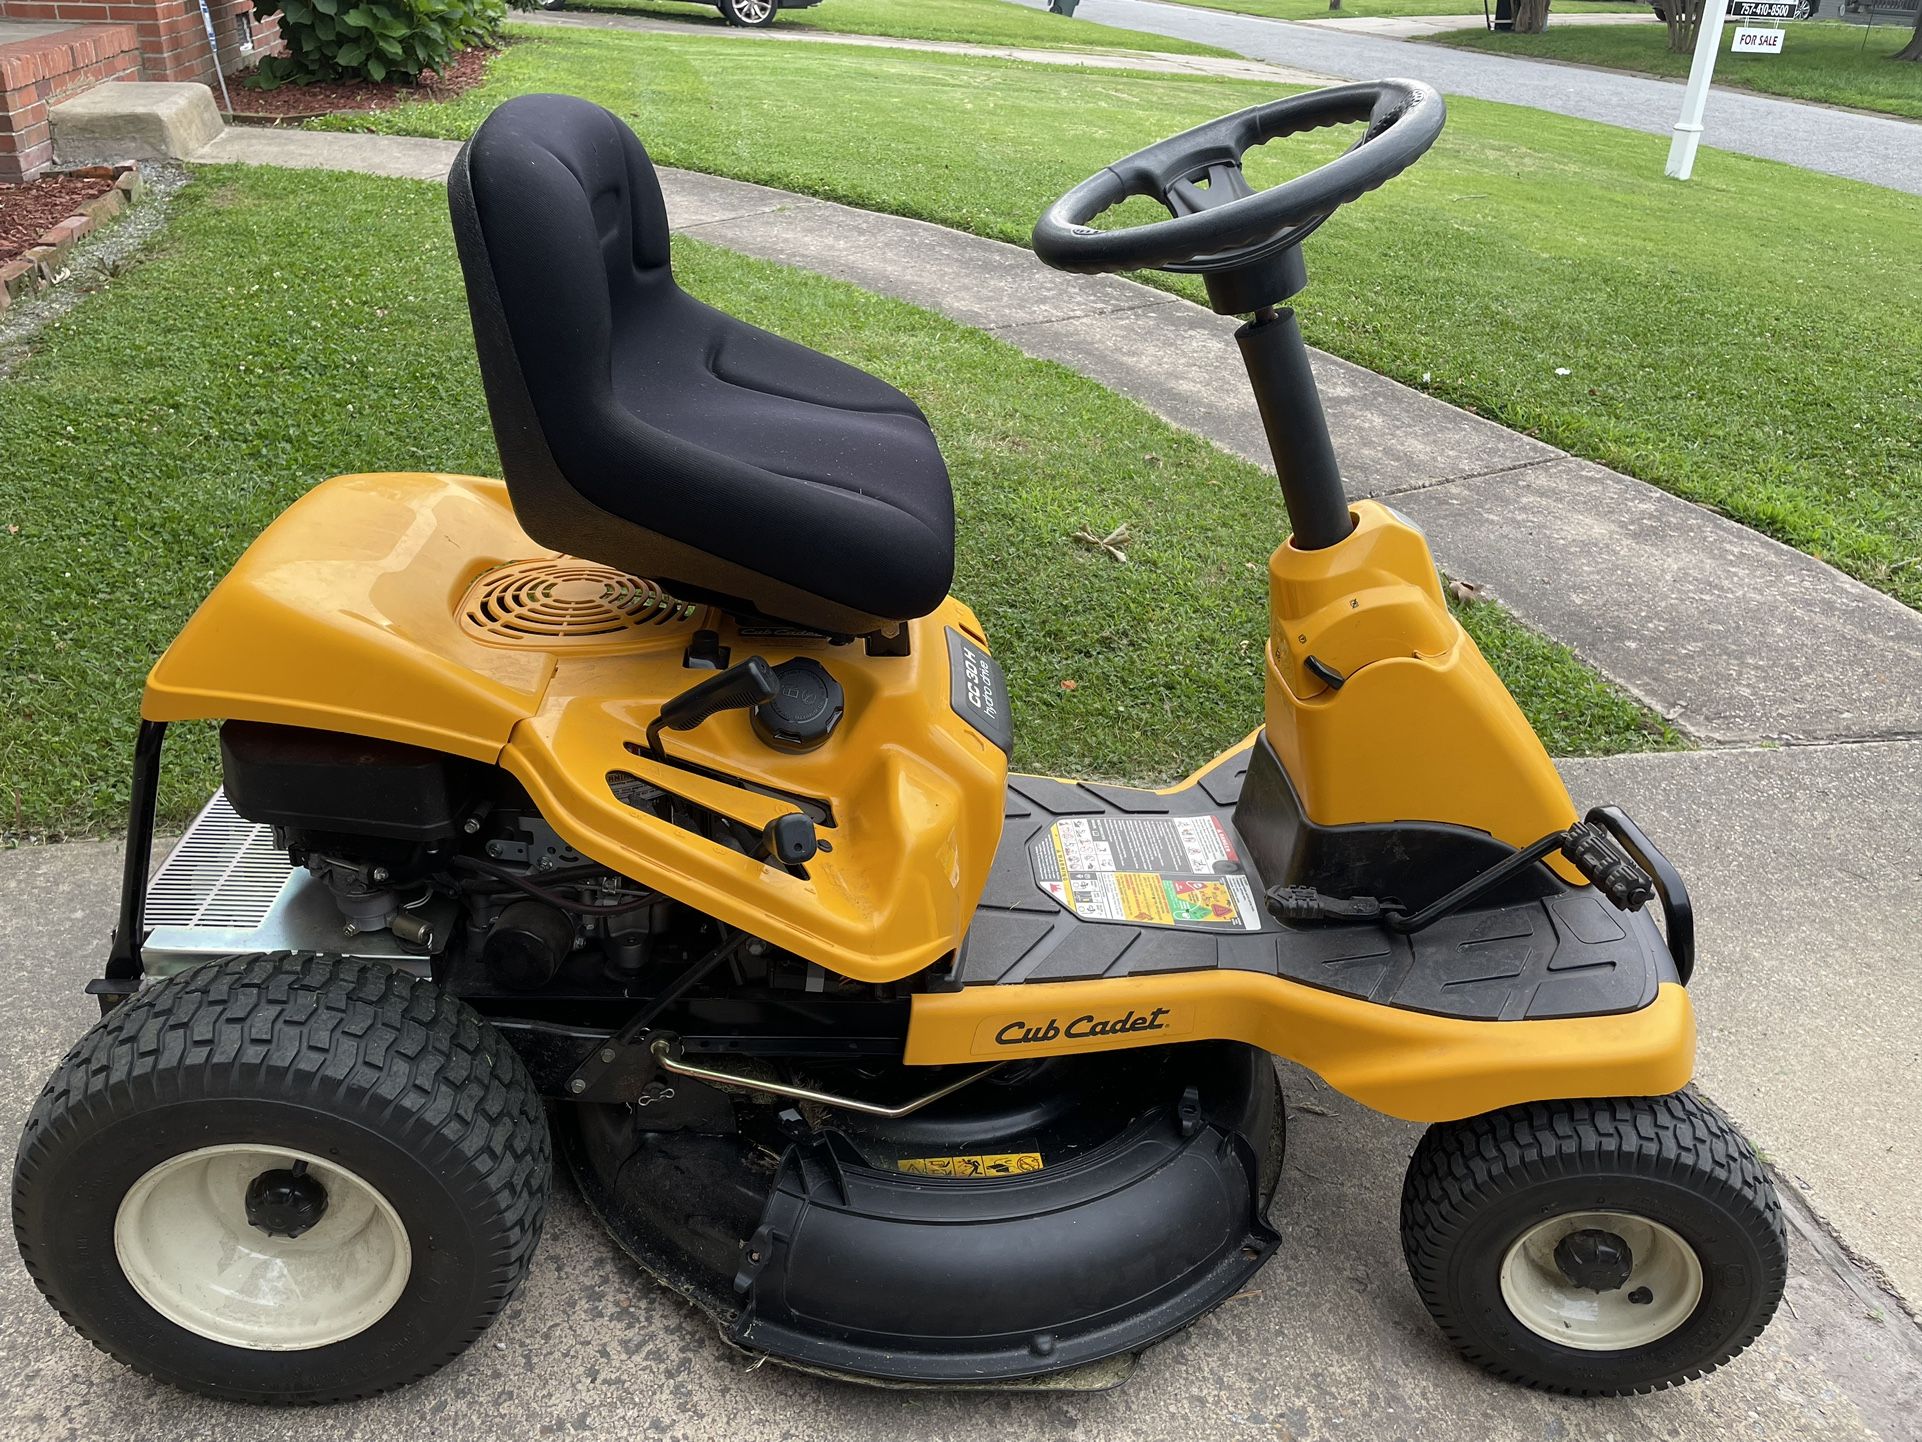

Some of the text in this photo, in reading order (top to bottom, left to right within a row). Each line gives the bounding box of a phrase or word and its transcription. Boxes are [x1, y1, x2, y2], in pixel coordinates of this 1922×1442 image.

[1740, 3, 1789, 17] 757-410-8500
[1740, 34, 1778, 46] FOR SALE
[963, 646, 981, 708] CC 30 H
[979, 660, 997, 719] hydro drive
[995, 1007, 1171, 1045] Cub Cadet
